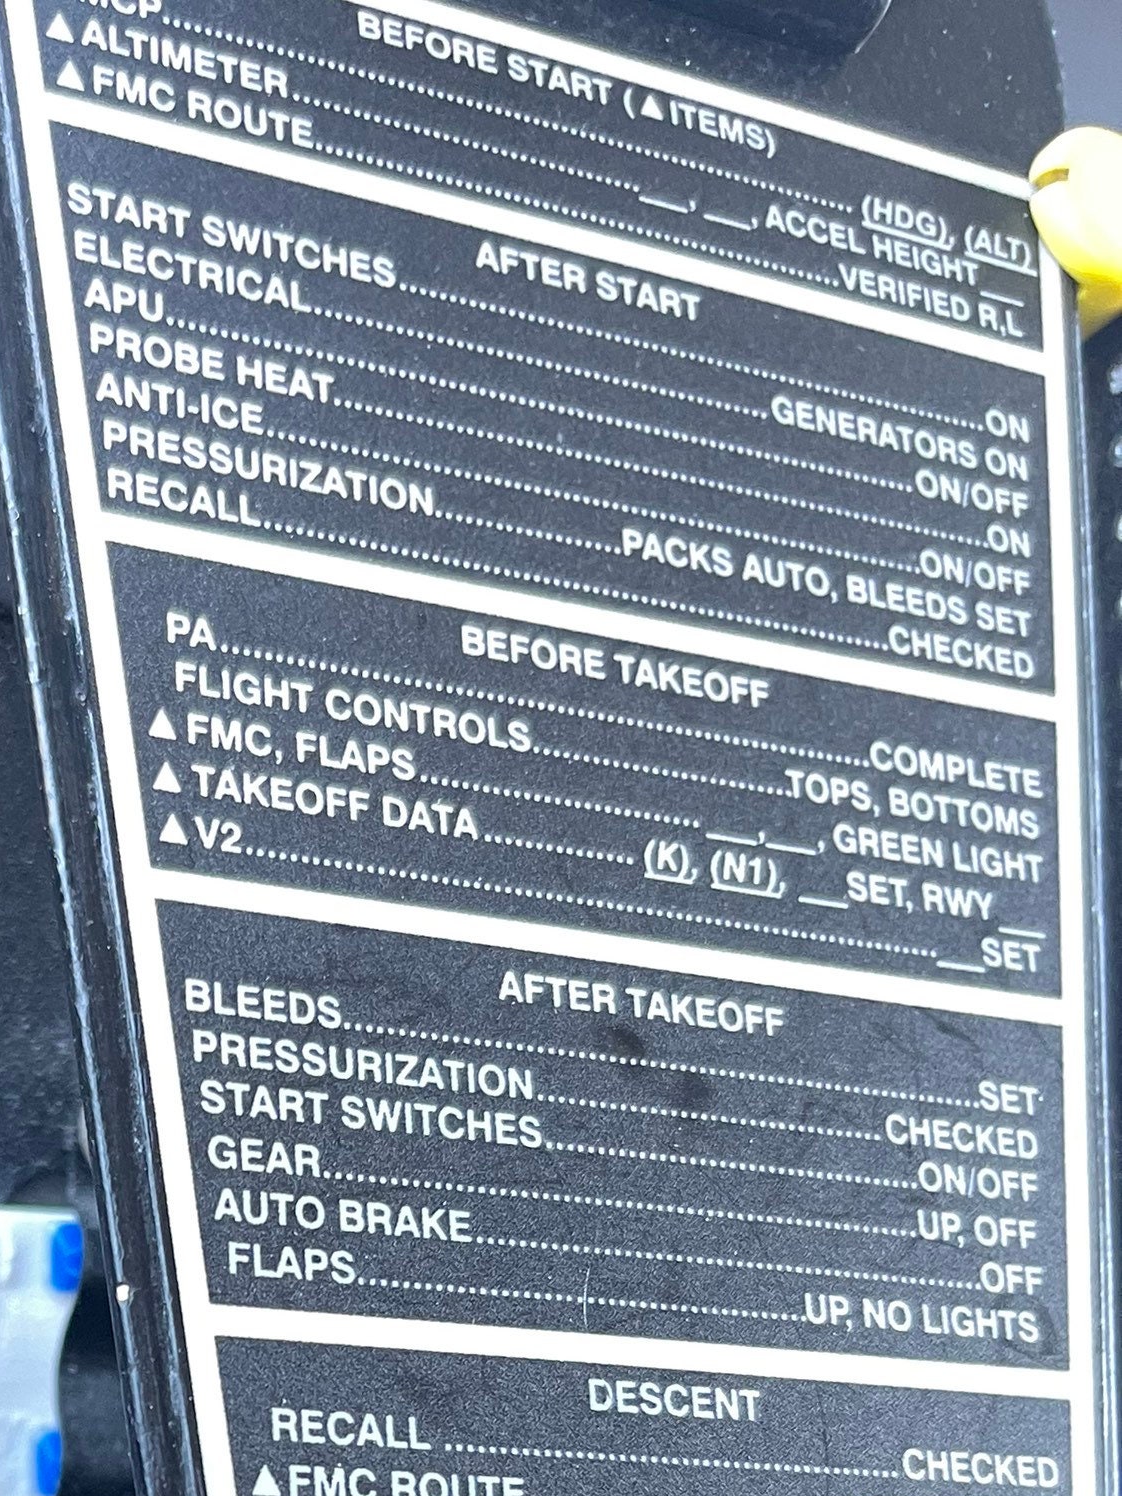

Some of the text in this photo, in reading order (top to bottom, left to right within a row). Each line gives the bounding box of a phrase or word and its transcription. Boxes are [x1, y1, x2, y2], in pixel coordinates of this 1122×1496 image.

[80, 0, 162, 18] CP
[357, 10, 498, 75] BEFORE
[507, 53, 613, 105] START
[81, 16, 979, 286] ALTIMETER ACCEL HEIGHT
[92, 62, 176, 113] FMC
[187, 88, 314, 149] ROUTE
[838, 262, 971, 322] VERIFIED
[67, 180, 1031, 444] START SWITCHES ON
[475, 240, 701, 321] AFTER START
[73, 227, 1029, 482] ELECTRICAL GENERATORS ON
[83, 275, 1029, 519] APU ON/OFF
[89, 319, 1032, 558] PROBE HEAT ON
[95, 370, 1031, 596] ANTI-ICE ON/OFF
[102, 416, 1032, 638] PRESSURIZATION PACKS AUTO, BLEEDS SET
[107, 464, 1036, 679] RECALL CHECKED
[166, 610, 1045, 799] PA COMPLETE
[461, 624, 770, 708] BEFORE TAKEOFF
[174, 660, 1041, 840] FLIGHT CONTROLS TOPS, BOTTOMS
[186, 711, 1044, 884] FMC, FLAPS GREEN LIGHT
[190, 762, 371, 821] TAKEOFF
[382, 795, 479, 841] DATA
[846, 870, 914, 914] SET,
[921, 881, 994, 921] RWY
[193, 815, 242, 854] V2
[184, 977, 1036, 1116] BLEEDS SET
[498, 970, 785, 1037] AFTER TAKEOFF
[192, 1028, 1040, 1160] PRESSURIZATION CHECKED
[200, 1079, 1040, 1203] START SWITCHES ON/OFF
[207, 1134, 1038, 1250] GEAR UP, OFF
[214, 1187, 1043, 1296] AUTO BRAKE OFF
[228, 1240, 1042, 1344] FLAPS UP, NO LIGHTS
[271, 1407, 1060, 1489] RECALL CHECKED
[587, 1377, 762, 1423] DESCENT
